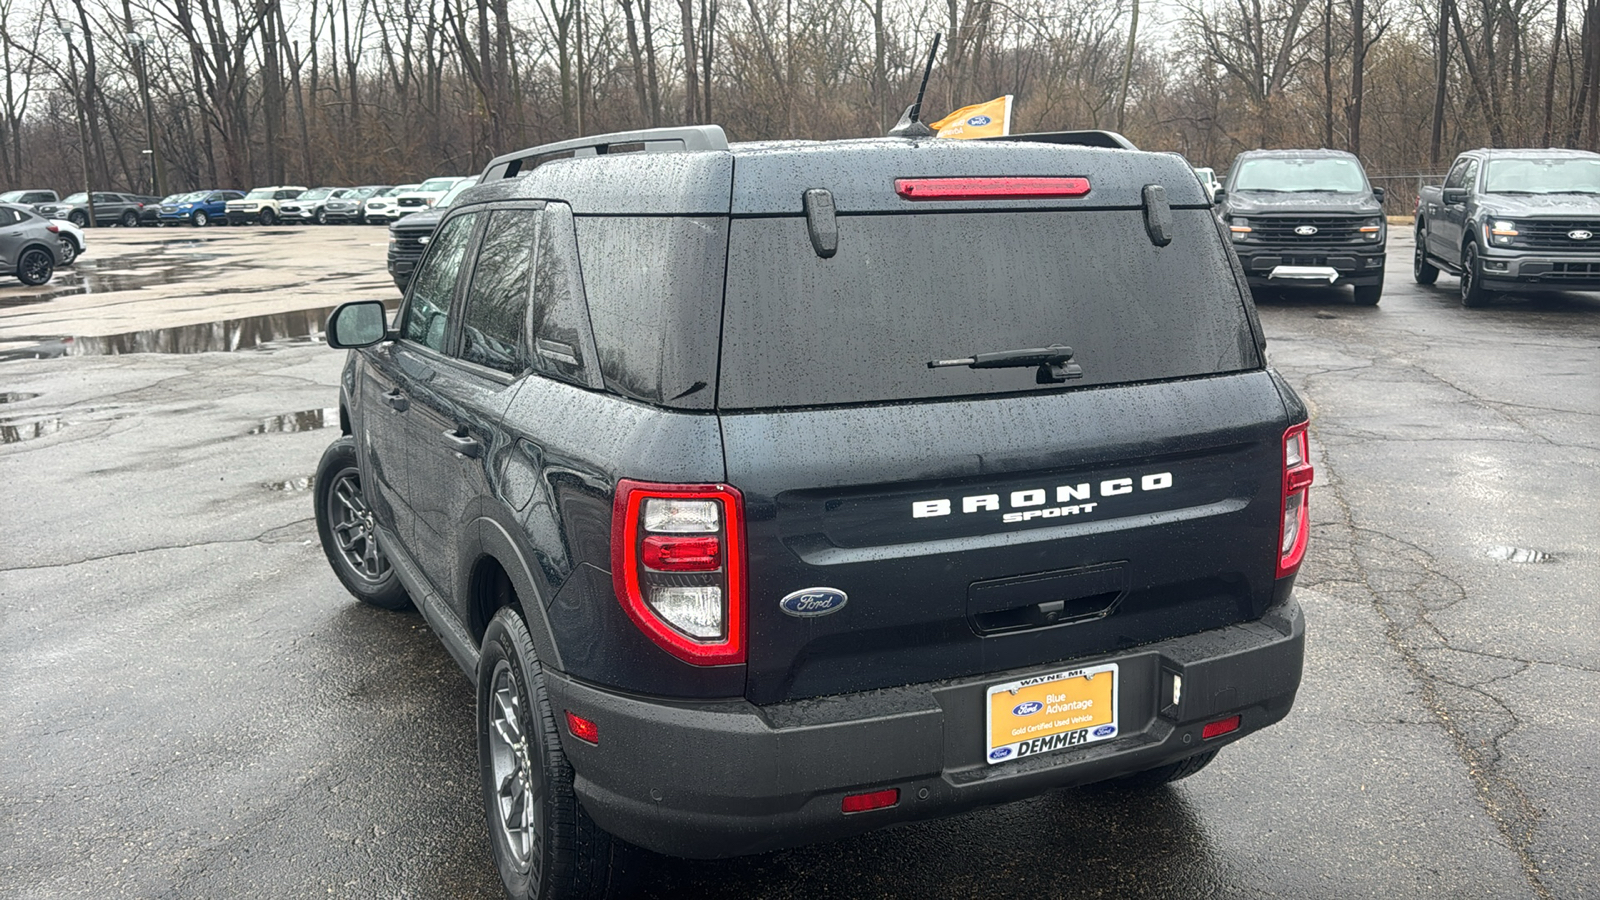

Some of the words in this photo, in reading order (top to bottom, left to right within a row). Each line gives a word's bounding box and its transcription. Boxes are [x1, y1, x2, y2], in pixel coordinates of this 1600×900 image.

[912, 471, 1173, 519] BRONCO
[1002, 502, 1098, 524] SPORT
[796, 593, 833, 611] Ford
[1045, 698, 1093, 715] Advantage
[1046, 693, 1067, 704] Blue
[1017, 703, 1039, 715] Ford
[1011, 726, 1027, 737] Gold
[1027, 721, 1053, 733] Certified
[1054, 719, 1070, 728] Used
[1071, 714, 1093, 724] Vehicle
[1096, 725, 1113, 736] Ford
[1017, 729, 1089, 757] DEMMER
[993, 748, 1008, 758] Ford
